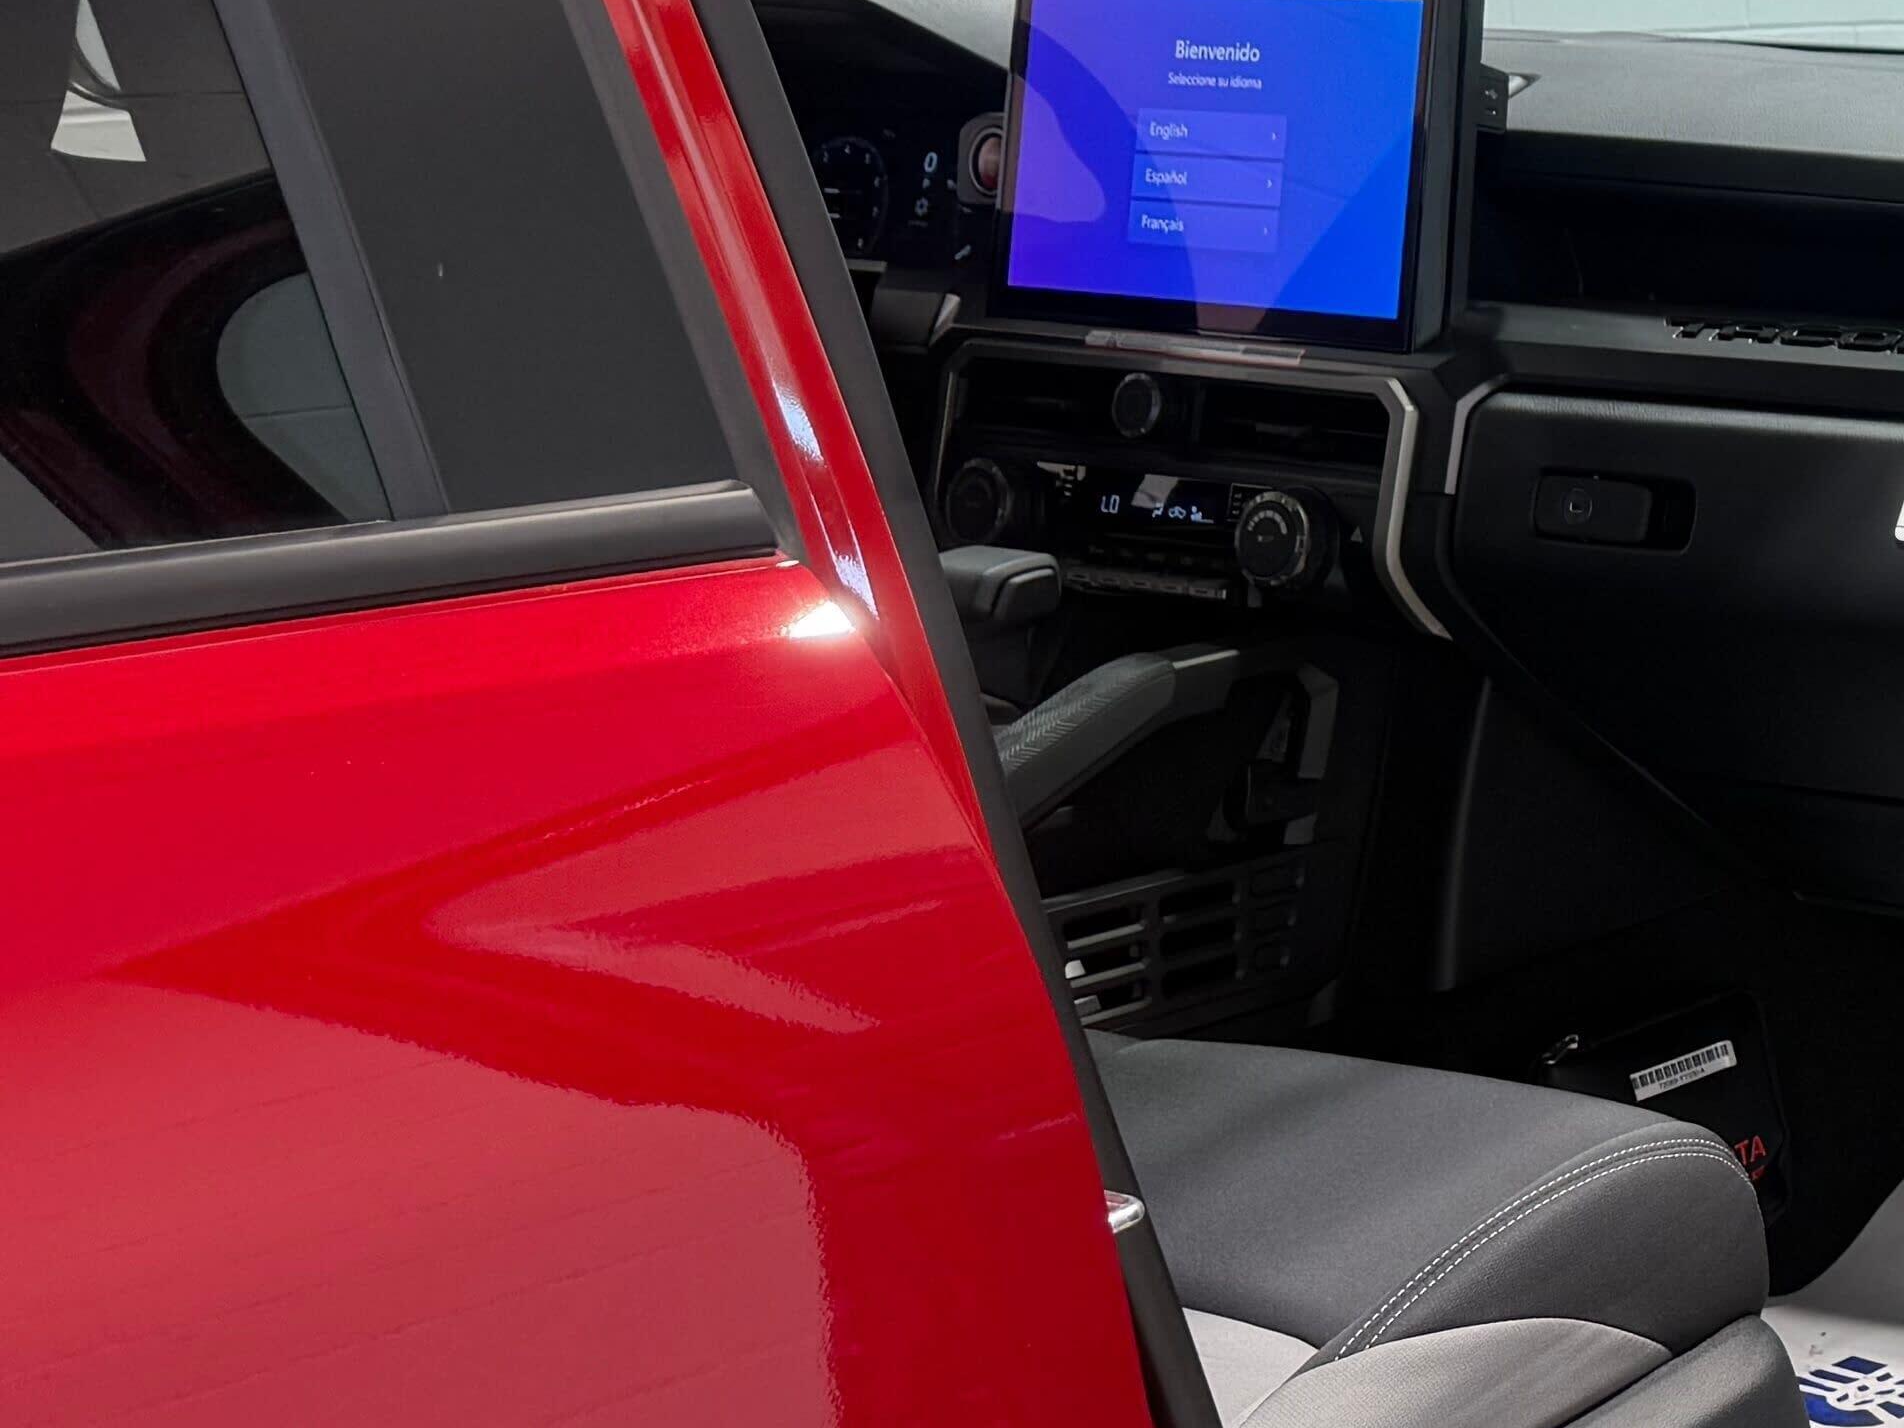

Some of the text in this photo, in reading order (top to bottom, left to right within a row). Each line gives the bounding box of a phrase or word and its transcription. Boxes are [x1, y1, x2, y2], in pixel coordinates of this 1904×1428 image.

[1174, 39, 1260, 62] Bienvenido
[1168, 72, 1262, 90] Seleccione su idioma
[1149, 121, 1188, 140] English
[1144, 168, 1188, 186] Español
[1141, 214, 1185, 234] Français
[1734, 1134, 1766, 1167] TA
